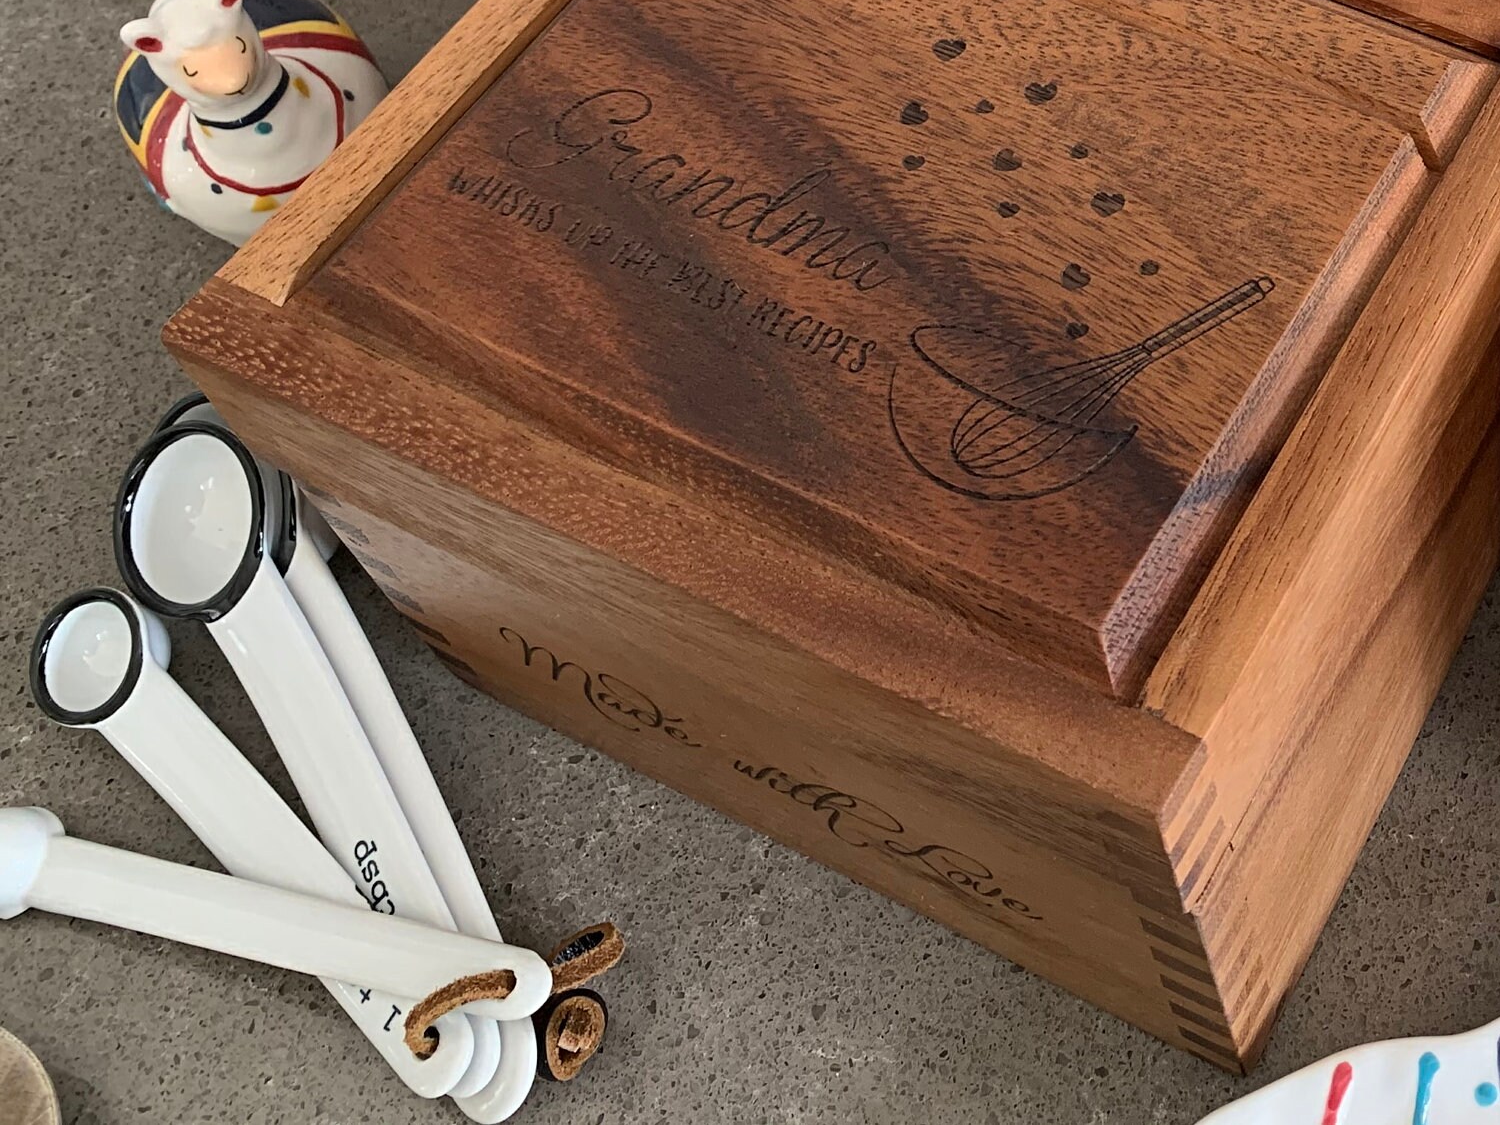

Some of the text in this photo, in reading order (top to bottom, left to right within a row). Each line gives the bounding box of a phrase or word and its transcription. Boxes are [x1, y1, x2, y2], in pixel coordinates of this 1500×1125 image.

[448, 166, 877, 373] WHISKS UP THE BEST RECIPES
[505, 88, 894, 292] Grandma
[499, 625, 1044, 921] Made with Love
